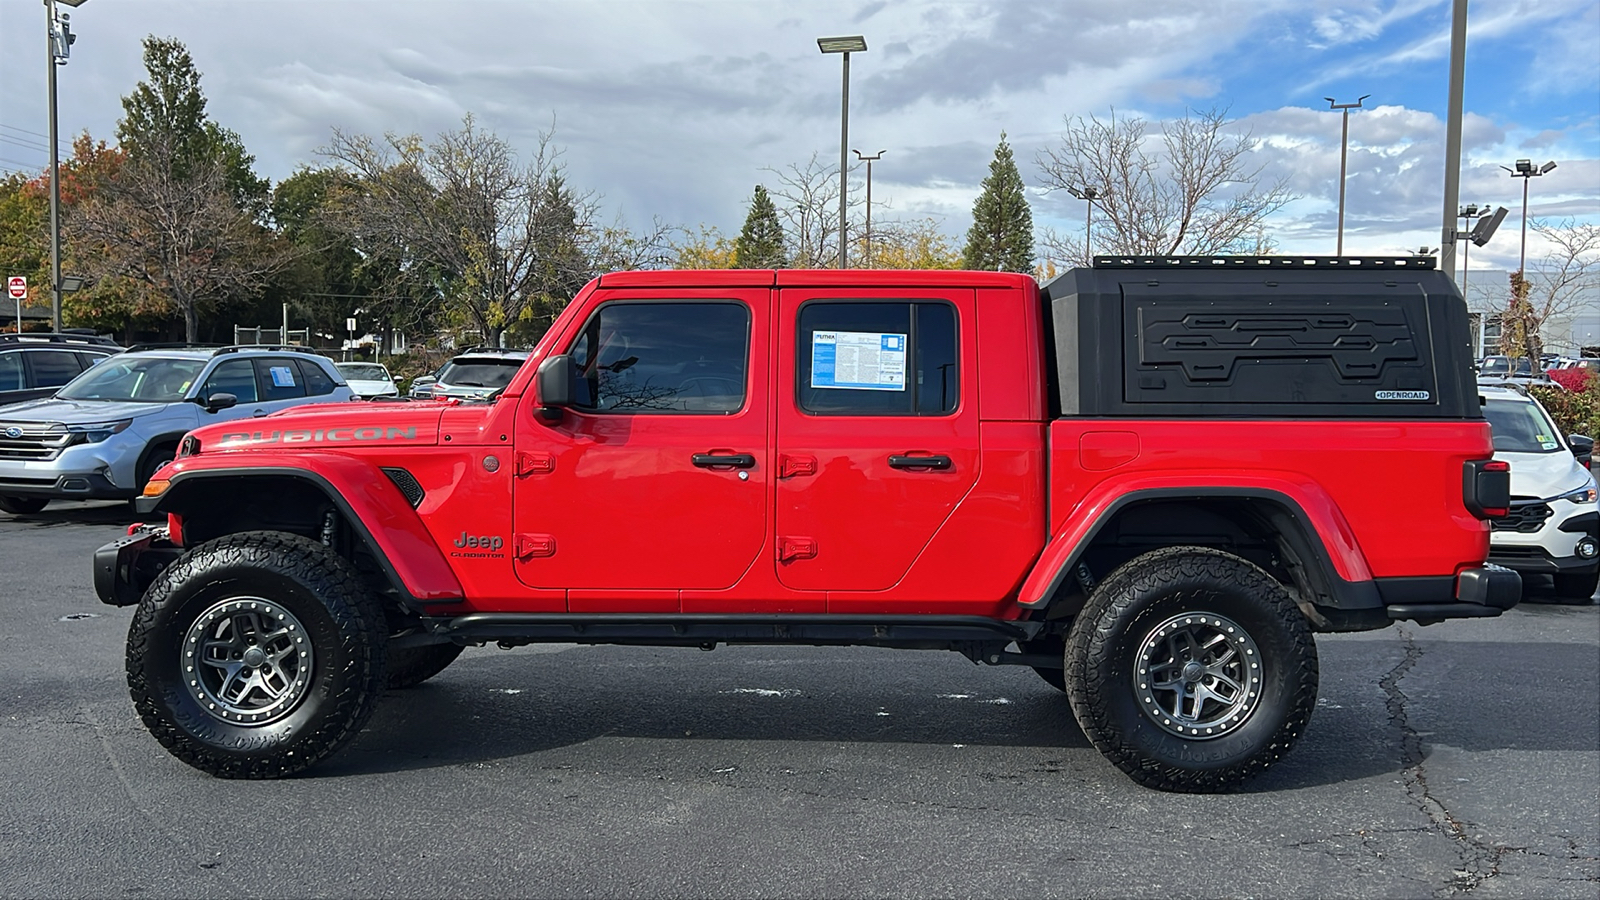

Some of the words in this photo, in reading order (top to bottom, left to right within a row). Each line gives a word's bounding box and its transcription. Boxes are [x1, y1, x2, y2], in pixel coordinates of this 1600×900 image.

[1380, 391, 1425, 399] OPENROAD
[220, 426, 417, 445] RUBICON
[453, 531, 503, 551] Jeep
